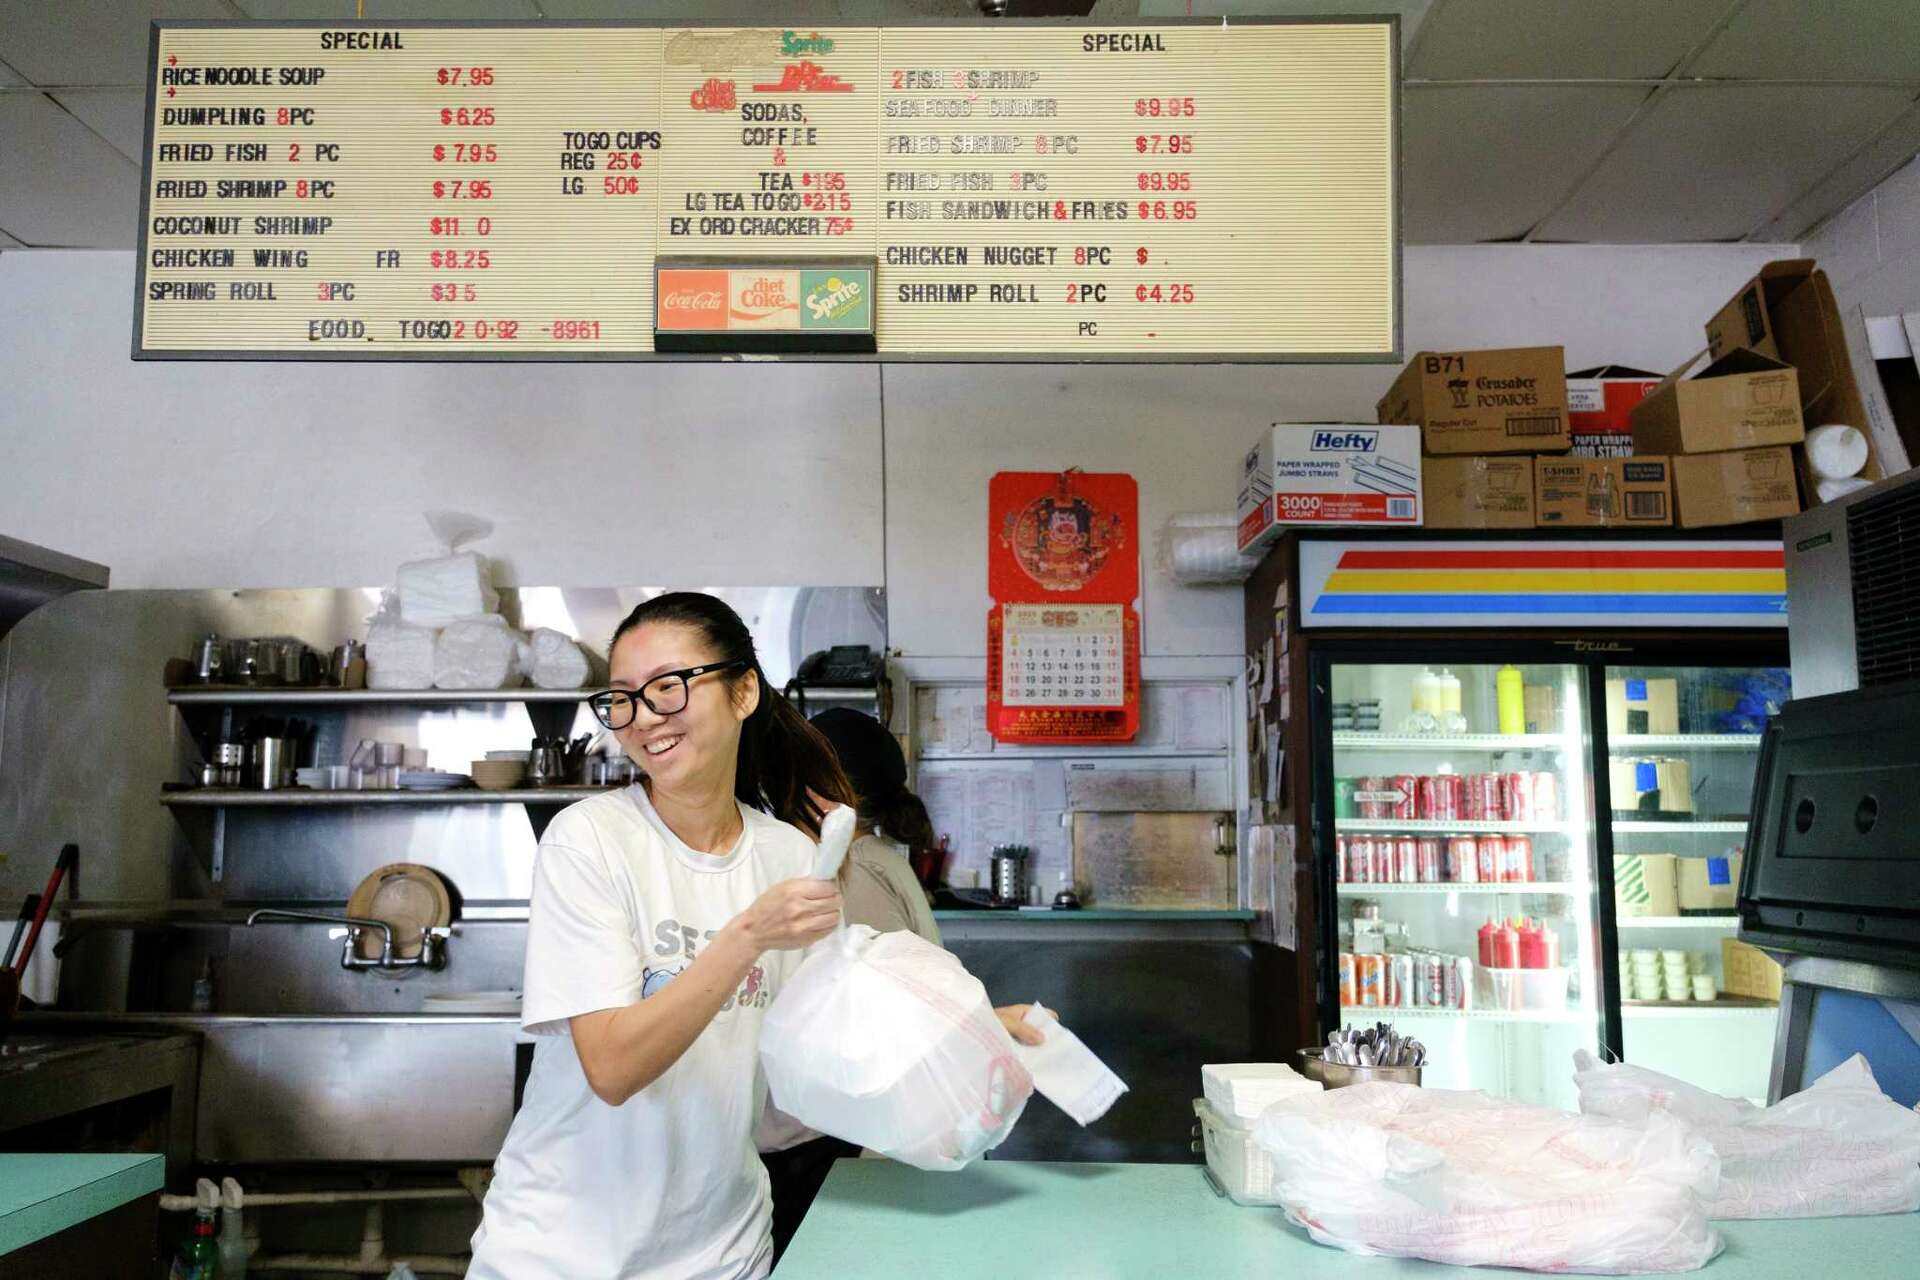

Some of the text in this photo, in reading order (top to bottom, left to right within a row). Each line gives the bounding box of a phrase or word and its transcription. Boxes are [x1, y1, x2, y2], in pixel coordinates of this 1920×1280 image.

[321, 32, 403, 50] SPECIAL
[1083, 34, 1166, 52] SPECIAL
[162, 68, 325, 85] RICE NOODLE SOUP
[437, 68, 494, 87] $7.95
[741, 103, 807, 124] SODAS,
[988, 99, 1057, 117] DINNER
[1135, 97, 1194, 117] $9.95
[164, 108, 265, 125] DUMPLING
[441, 107, 495, 126] $6.25
[563, 132, 661, 150] TOGO CUPS
[742, 128, 817, 146] COFFEE
[887, 135, 940, 154] FRIED
[950, 135, 1023, 154] SHRIMP
[1135, 135, 1192, 154] $7.95
[159, 144, 340, 162] FRIED FISH 2 PC
[561, 152, 642, 170] REG 25¢
[773, 148, 786, 166] &
[156, 181, 207, 198] FRIED
[217, 181, 286, 198] SHRIMP
[433, 180, 492, 199] $7.95
[563, 177, 639, 194] LG 50¢
[759, 172, 793, 190] TEA
[887, 172, 940, 191] FRIED
[951, 172, 993, 191] FISH
[1137, 172, 1191, 191] $9.95
[686, 193, 704, 211] LG
[713, 193, 744, 211] TEA
[887, 201, 930, 219] FISH
[1137, 201, 1197, 219] $6.95
[153, 217, 332, 235] COCONUT SHRIMP
[671, 218, 691, 235] EX
[700, 218, 735, 235] ORD
[741, 217, 819, 235] CRACKER
[152, 250, 400, 268] CHICKEN WING FR
[430, 250, 490, 269] $8.25
[887, 247, 968, 265] CHICKEN
[984, 247, 1057, 265] NUGGET
[150, 282, 215, 300] SPRING
[230, 283, 276, 300] ROLL
[753, 277, 785, 293] diet
[899, 284, 977, 303] SHRIMP
[990, 284, 1039, 303] ROLL
[740, 290, 786, 308] Coke
[806, 280, 861, 320] Sprite
[1078, 322, 1097, 336] PC
[1426, 356, 1464, 374] B71
[1475, 376, 1537, 391] Crusader
[1478, 393, 1537, 408] POTATOES
[1315, 433, 1373, 451] Hefty
[1574, 435, 1633, 445] PAPER WRAPP
[1277, 461, 1340, 469] PAPER WRAPPED
[1280, 496, 1320, 510] 3000
[1285, 510, 1315, 518] COUNT
[1091, 636, 1098, 644] 2
[1026, 663, 1035, 671] 12
[1042, 663, 1051, 671] 13
[1059, 663, 1068, 671] 14
[1075, 663, 1084, 671] 15
[1091, 663, 1100, 671] 16
[1026, 676, 1035, 684] 19
[1042, 676, 1051, 684] 20
[1058, 676, 1067, 684] 21
[1074, 676, 1084, 684] 22
[1091, 676, 1100, 684] 23
